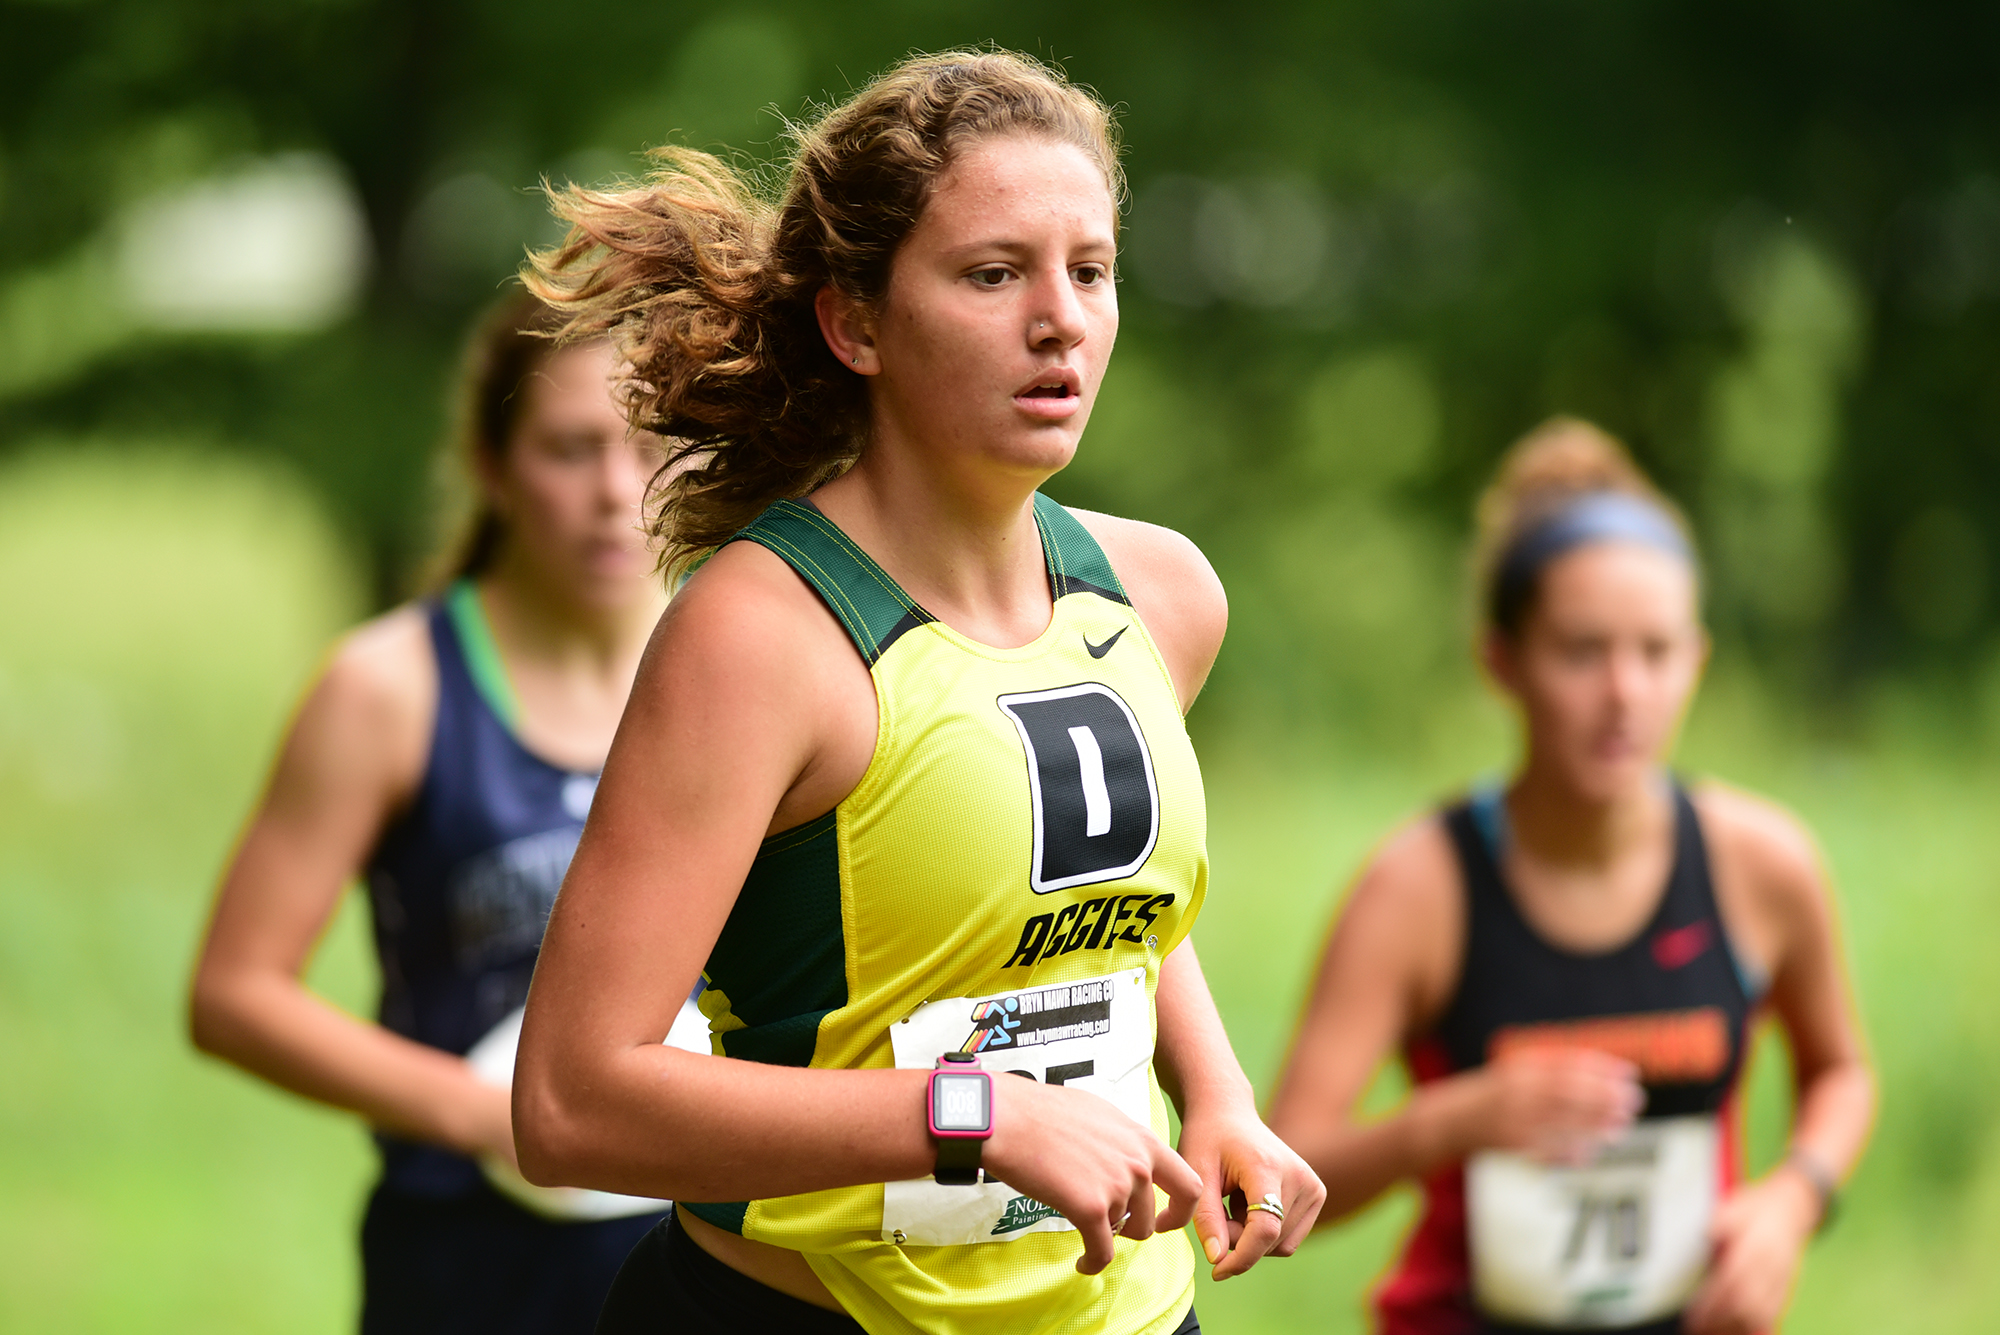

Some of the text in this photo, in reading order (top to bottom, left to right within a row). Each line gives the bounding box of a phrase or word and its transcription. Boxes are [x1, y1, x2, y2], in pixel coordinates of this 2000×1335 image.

[996, 681, 1160, 895] D
[1001, 893, 1175, 969] AGGIES
[1018, 979, 1114, 1015] BRYN MAWR RACING CO
[1016, 1020, 1109, 1046] www.brynmawrracing.com
[1014, 1198, 1051, 1215] NOL
